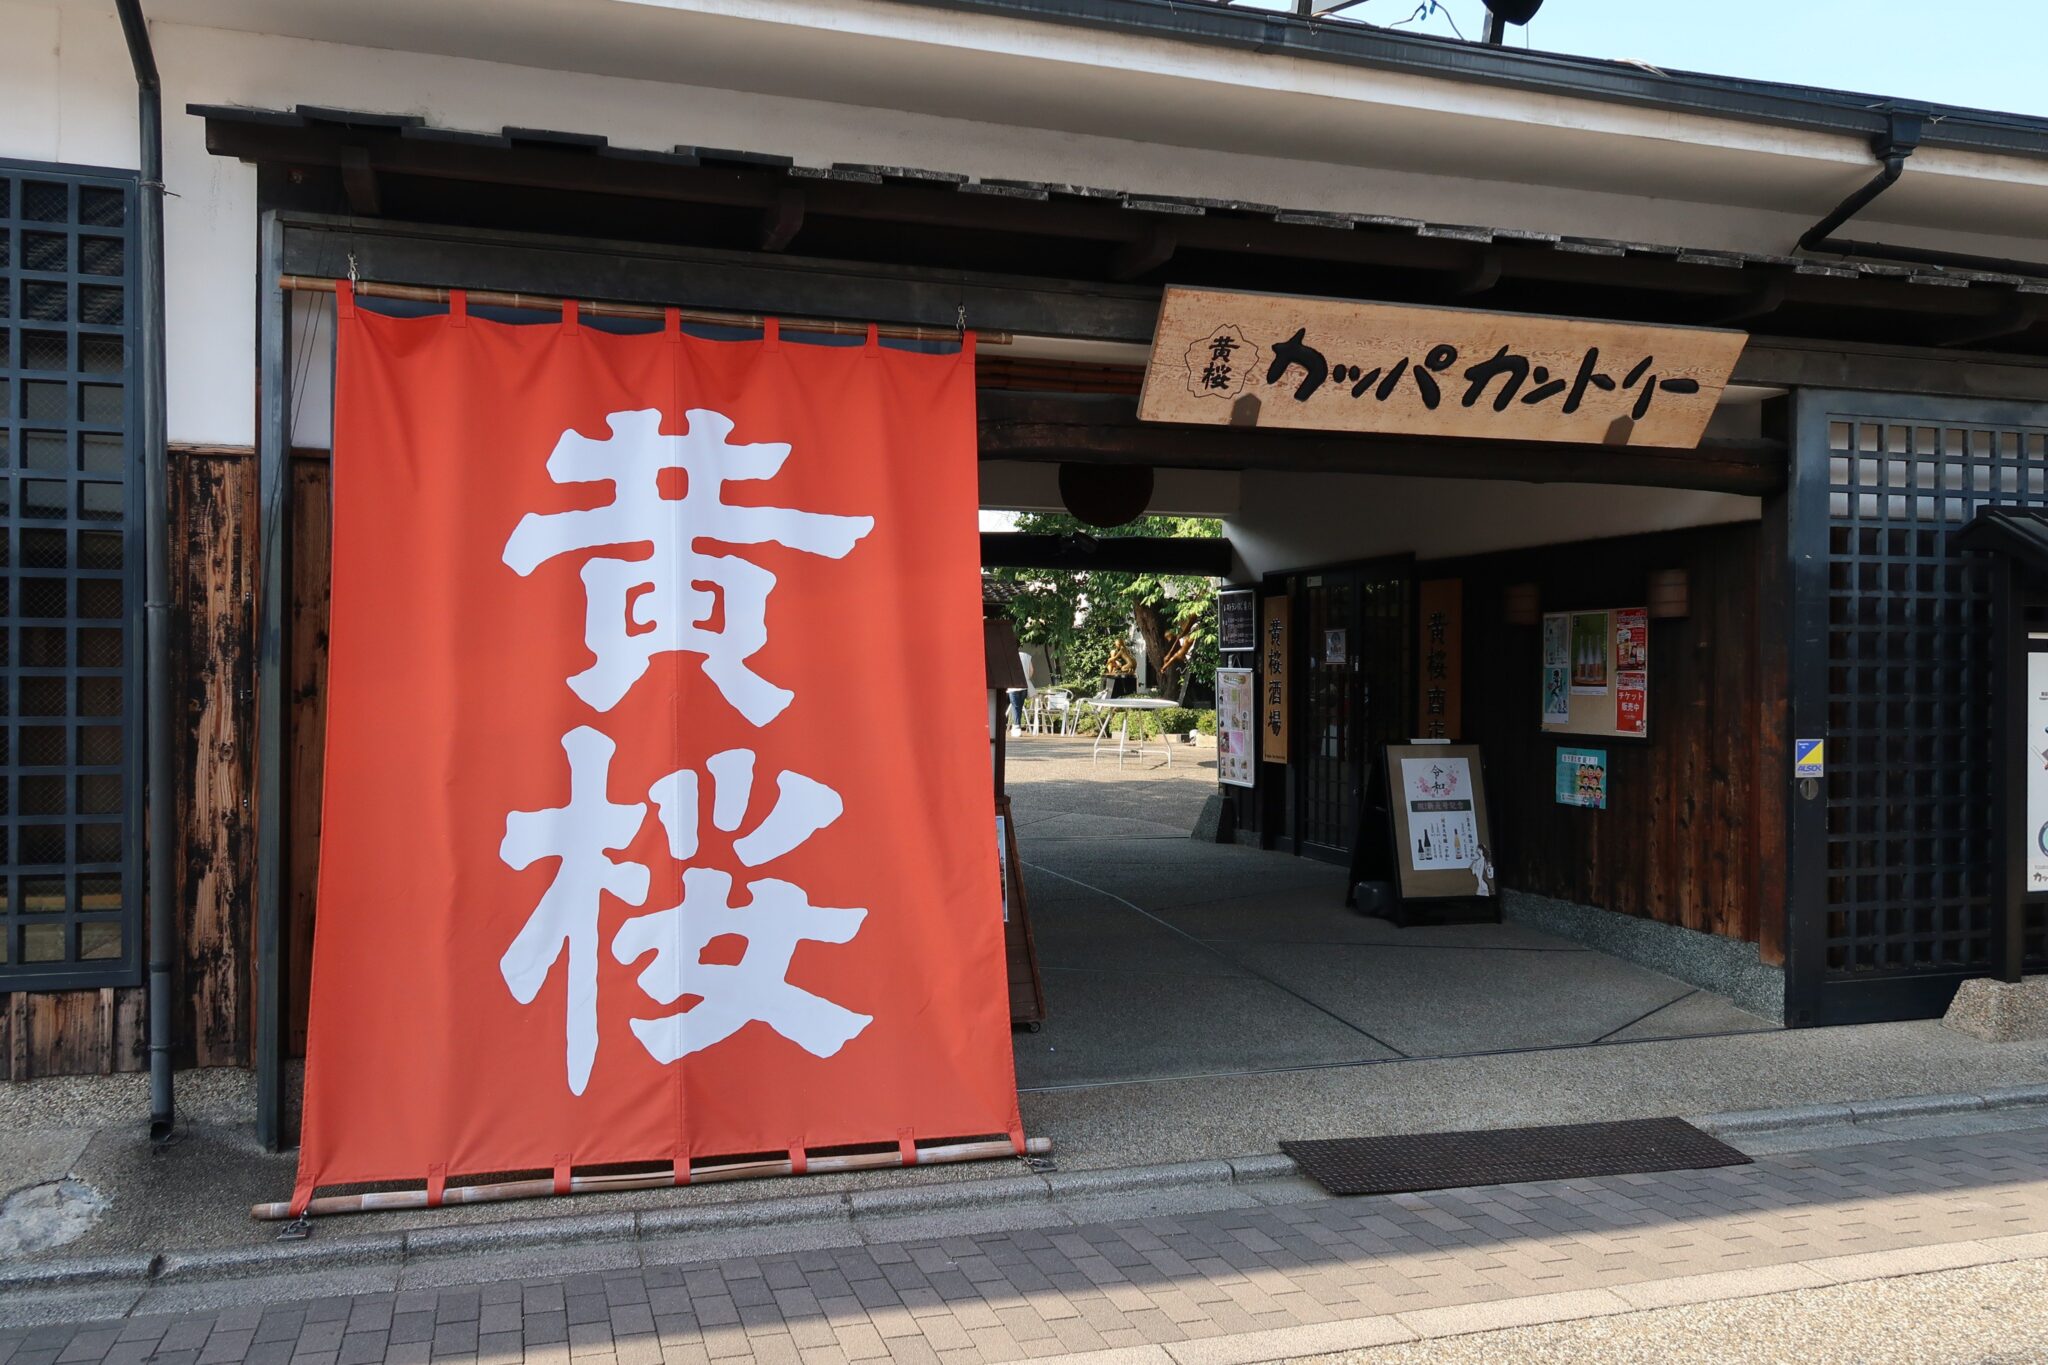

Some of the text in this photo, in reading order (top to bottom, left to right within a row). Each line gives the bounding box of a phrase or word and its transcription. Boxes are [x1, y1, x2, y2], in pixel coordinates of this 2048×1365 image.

[1202, 335, 1230, 391] 黄桜
[1267, 327, 1700, 421] カッパカントリー
[1267, 618, 1284, 737] 黄桜酒場
[1618, 691, 1643, 702] チケット
[1621, 702, 1640, 712] 販売中
[499, 407, 875, 1097] 黄桜
[1797, 764, 1822, 772] ALSOK
[1430, 764, 1446, 795] 令和
